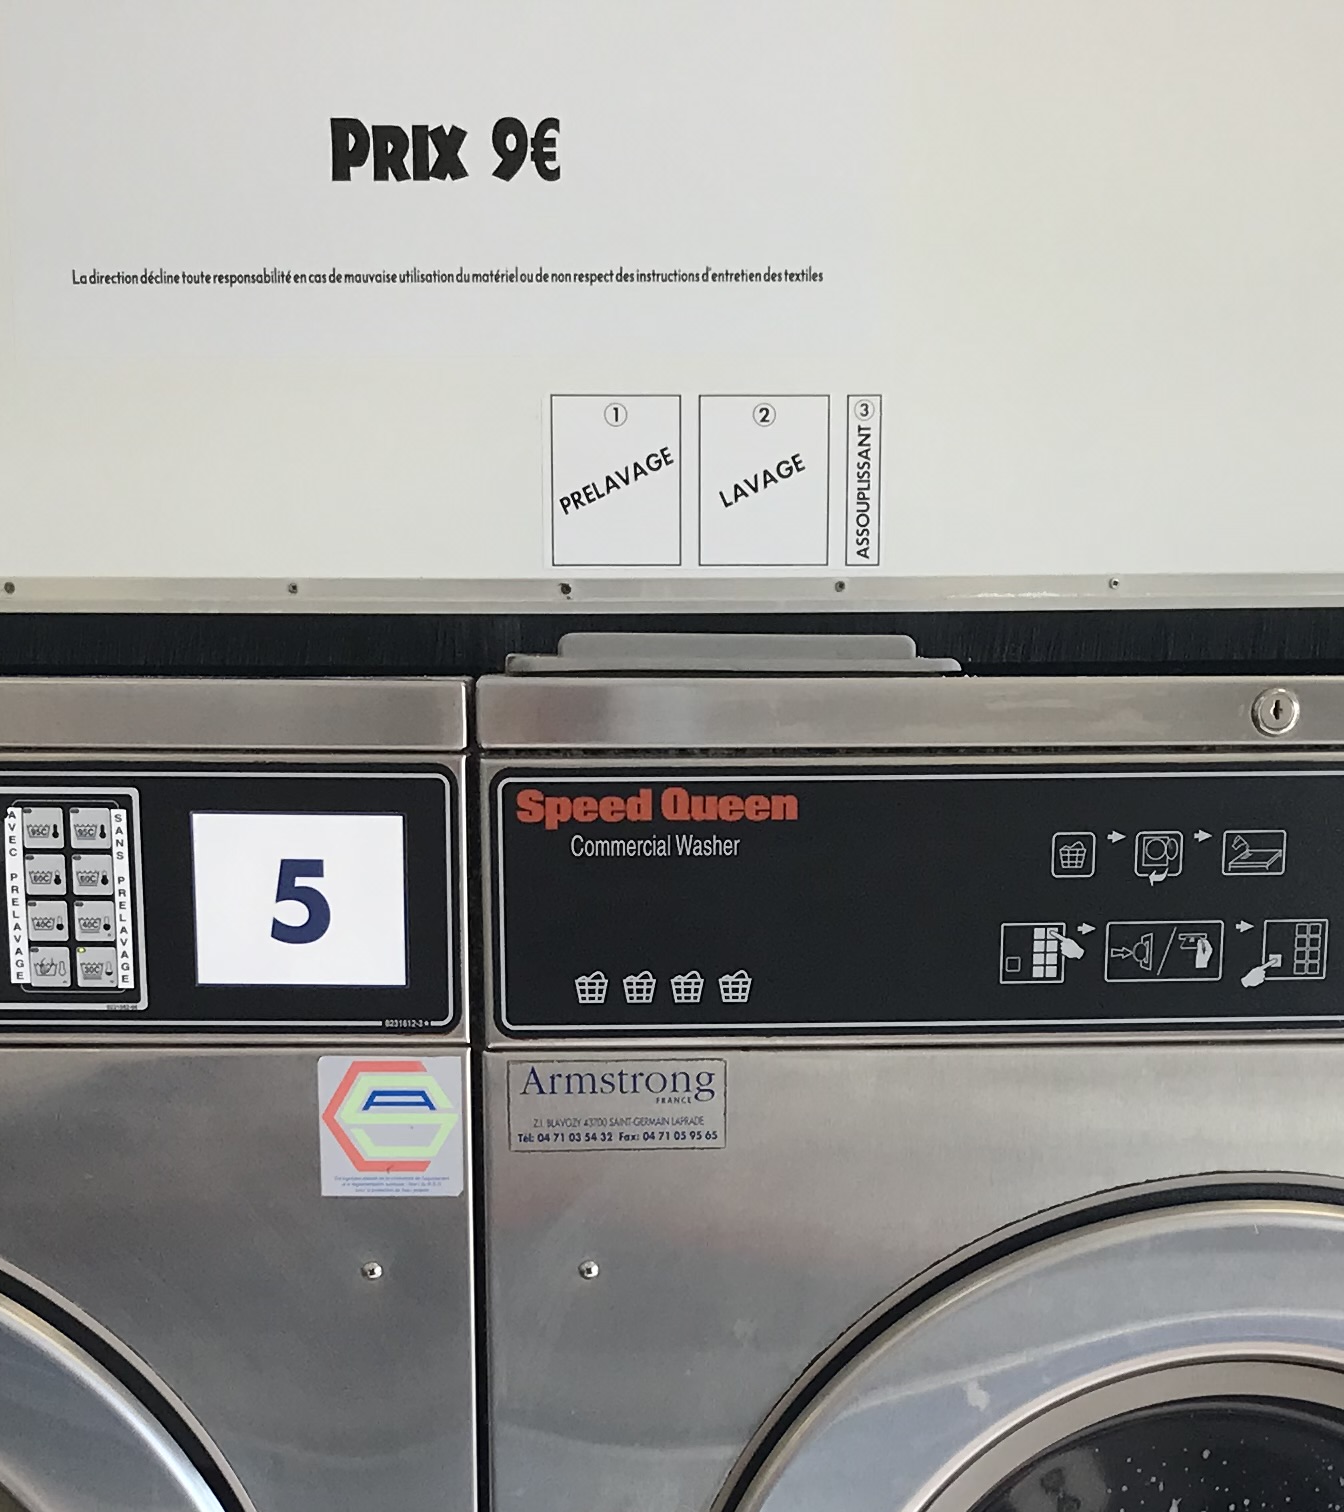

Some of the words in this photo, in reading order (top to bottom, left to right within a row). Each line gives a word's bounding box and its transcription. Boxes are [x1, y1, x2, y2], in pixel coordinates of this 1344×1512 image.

[491, 116, 560, 182] 9€
[72, 269, 87, 285] La
[89, 268, 138, 286] direction
[140, 267, 180, 285] décline
[182, 269, 211, 285] toute
[213, 266, 291, 288] responsabilité
[293, 271, 306, 284] en
[308, 271, 327, 284] cas
[328, 266, 342, 284] de
[344, 271, 397, 284] mauvaise
[399, 266, 454, 284] utilisation
[456, 266, 470, 284] du
[472, 266, 518, 284] matériel
[520, 271, 534, 284] ou
[535, 266, 549, 284] de
[551, 270, 571, 284] non
[574, 268, 614, 287] respect
[616, 266, 635, 284] des
[637, 266, 700, 284] instructions
[702, 265, 762, 284] d'entretien
[764, 265, 782, 284] des
[784, 265, 824, 283] textiles
[559, 446, 674, 514] PRELAVAGE
[719, 454, 806, 507] LAVAGE
[856, 425, 871, 559] ASSOUPLISSANT
[516, 789, 653, 830] Speed
[661, 787, 798, 821] Queen
[8, 811, 18, 857] AVEC
[114, 814, 125, 860] SANS
[571, 835, 671, 857] Commercial
[676, 835, 740, 857] Washer
[270, 858, 331, 945] 5
[10, 873, 25, 980] PRELAVAGE
[117, 876, 130, 983] PRELAVAGE
[520, 1066, 715, 1102] Armstrong
[656, 1096, 692, 1104] FRANCE
[538, 1133, 550, 1142] 04
[553, 1133, 564, 1142] 71
[569, 1133, 582, 1142] 03
[585, 1132, 598, 1142] 54
[600, 1132, 613, 1142] 32
[619, 1132, 640, 1141] Fax:
[643, 1132, 656, 1141] 04
[658, 1131, 670, 1141] 71
[674, 1131, 687, 1140] 05
[689, 1131, 702, 1140] 95
[705, 1131, 718, 1140] 65
[609, 1116, 669, 1127] SAINT-GERMAIN
[672, 1116, 704, 1126] LAPRADE
